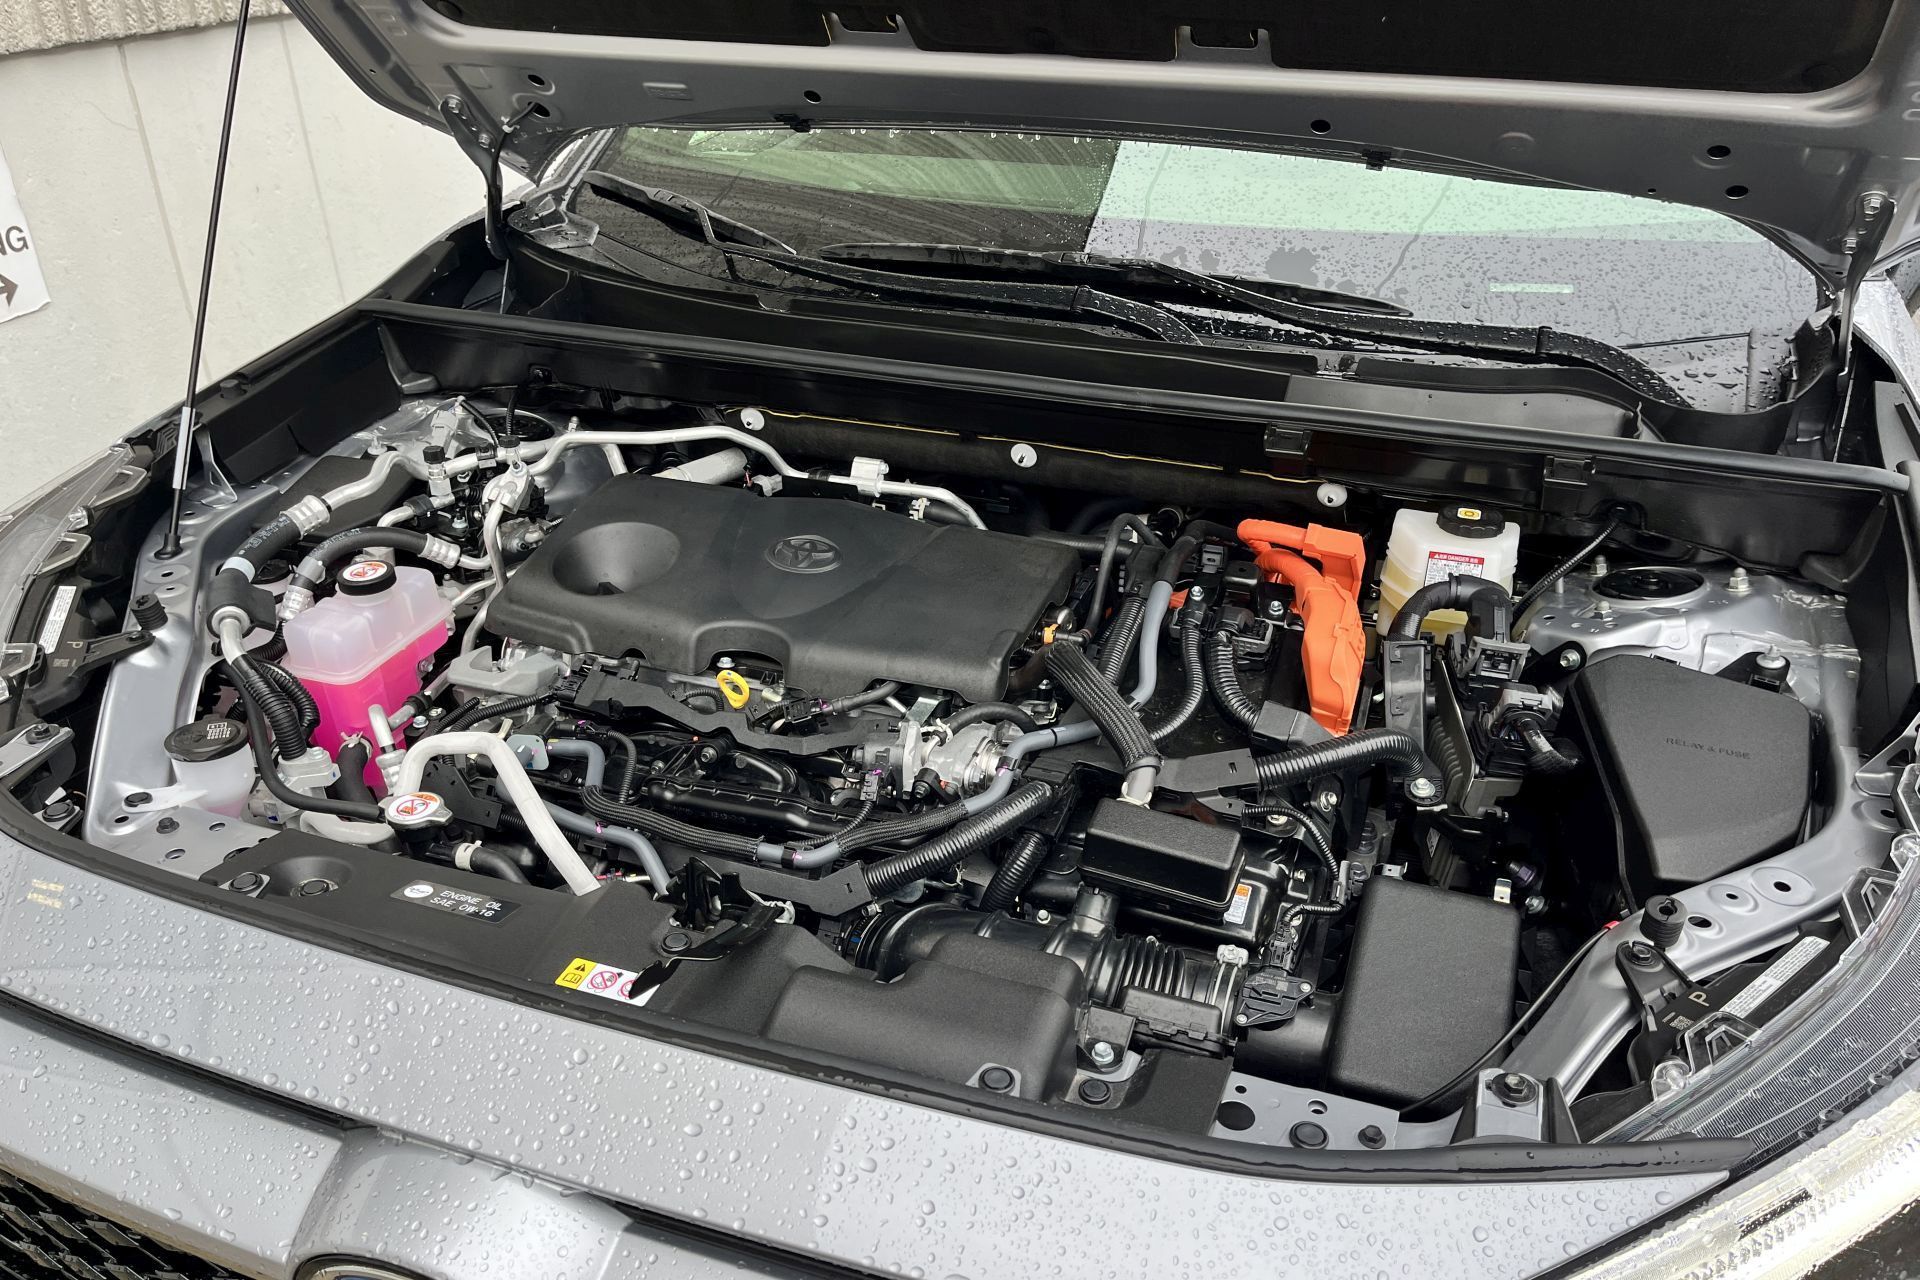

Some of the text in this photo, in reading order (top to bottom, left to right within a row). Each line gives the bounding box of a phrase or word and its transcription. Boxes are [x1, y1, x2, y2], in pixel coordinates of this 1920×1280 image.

[1665, 737, 1705, 751] RELAY
[1718, 747, 1752, 760] FUSE
[430, 897, 456, 908] SAE
[440, 890, 482, 906] ENGINE
[485, 901, 502, 911] OIL
[1688, 991, 1710, 1007] P
